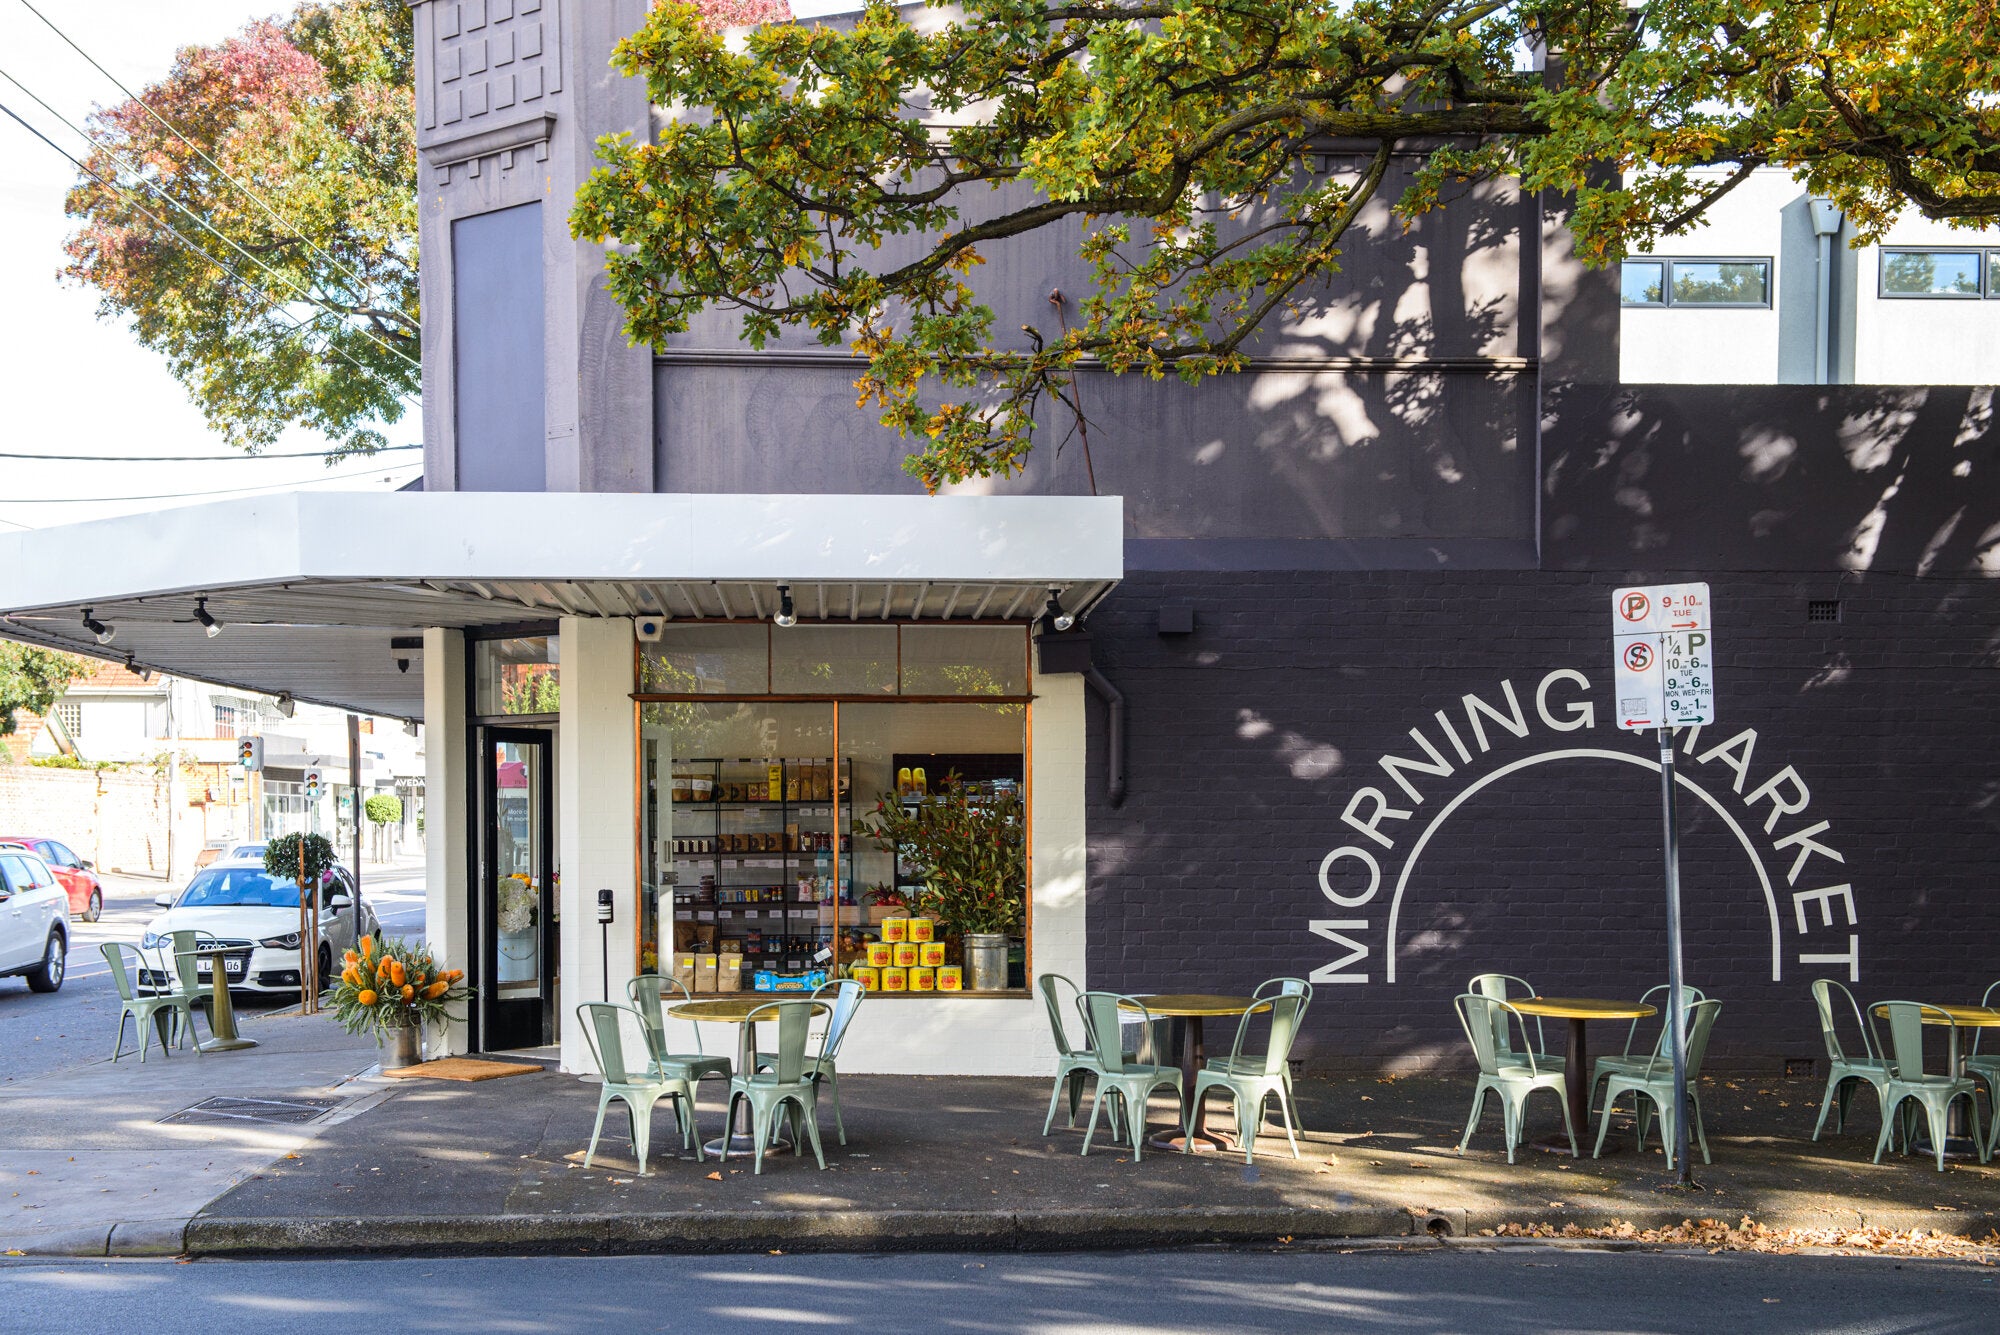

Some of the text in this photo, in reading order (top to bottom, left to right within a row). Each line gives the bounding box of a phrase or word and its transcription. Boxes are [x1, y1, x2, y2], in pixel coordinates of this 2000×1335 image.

[1673, 609, 1692, 617] TUE
[1688, 632, 1707, 656] P
[1680, 669, 1693, 677] TUE
[395, 778, 425, 787] AVEDA
[1309, 669, 1595, 984] MORNING
